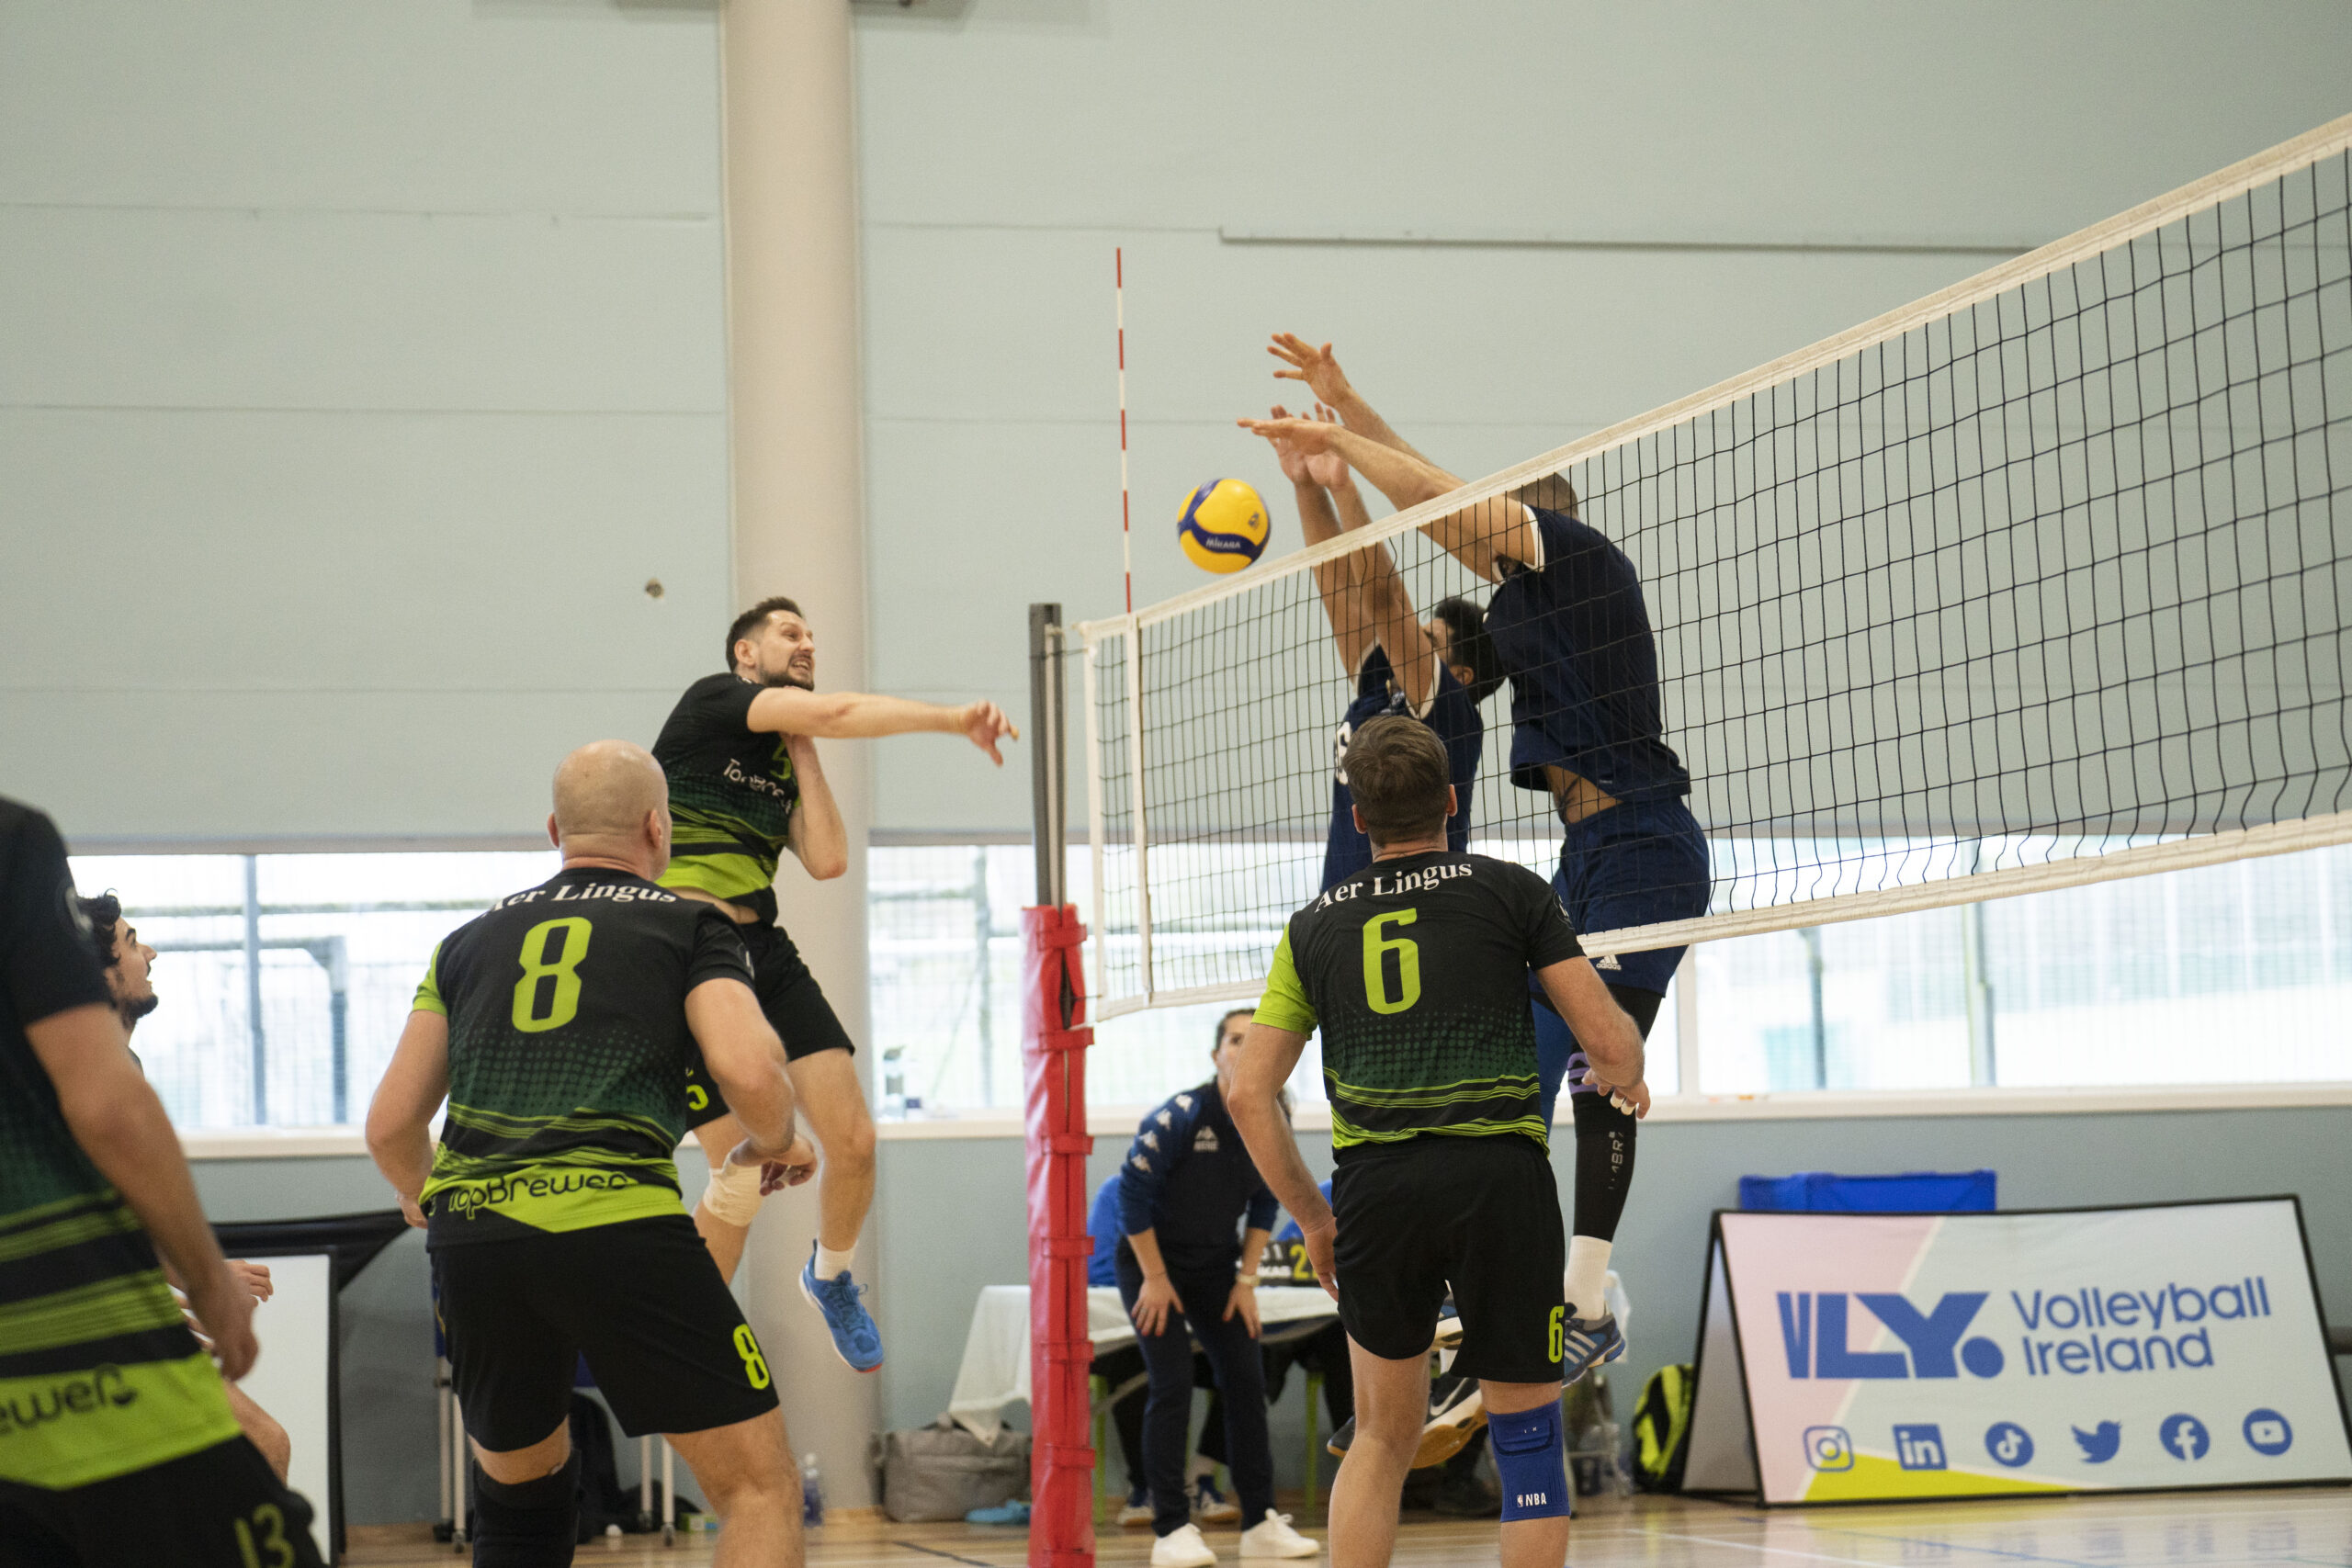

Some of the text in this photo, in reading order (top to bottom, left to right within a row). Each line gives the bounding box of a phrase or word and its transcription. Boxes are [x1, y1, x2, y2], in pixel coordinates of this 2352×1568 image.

[551, 883, 677, 903] Lingus
[1314, 863, 1473, 913] Aer Lingus
[512, 916, 593, 1033] 8
[1363, 908, 1421, 1015] 6
[1596, 963, 1622, 971] adidas
[2010, 1276, 2273, 1331] Volleyball
[733, 1324, 771, 1390] 8
[1548, 1305, 1565, 1363] 6
[2021, 1327, 2215, 1377] Ireland
[1525, 1492, 1547, 1506] NBA
[233, 1503, 296, 1568] 13
